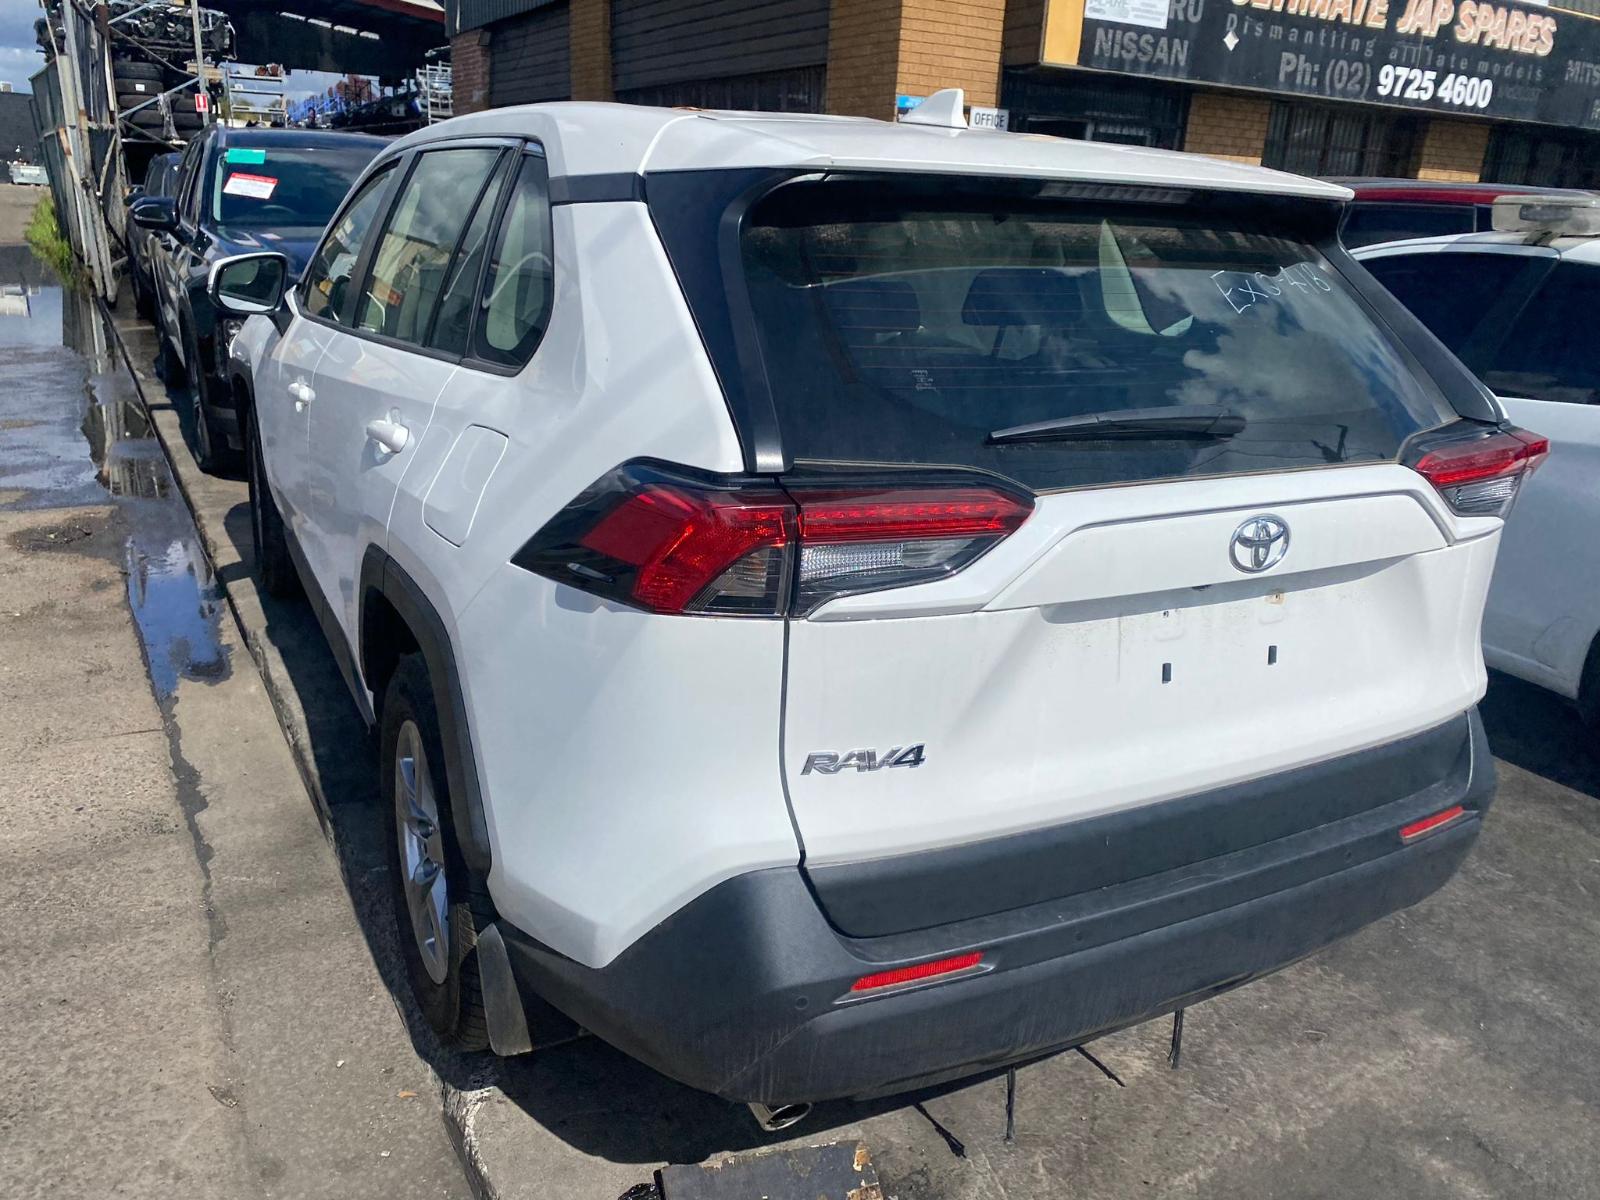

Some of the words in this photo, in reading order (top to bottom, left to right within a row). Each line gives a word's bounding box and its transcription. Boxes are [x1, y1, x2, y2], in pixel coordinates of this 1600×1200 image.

[1093, 27, 1189, 67] NISSAN
[1225, 13, 1376, 57] Dismantling
[1230, 0, 1388, 29] MATE
[1396, 0, 1455, 37] JAP
[1454, 0, 1558, 57] SPARES
[1324, 57, 1372, 98] (02)
[1376, 64, 1437, 101] 9725
[1436, 73, 1493, 109] 4600
[974, 112, 1005, 128] OFFICE
[800, 742, 926, 775] RAV4
